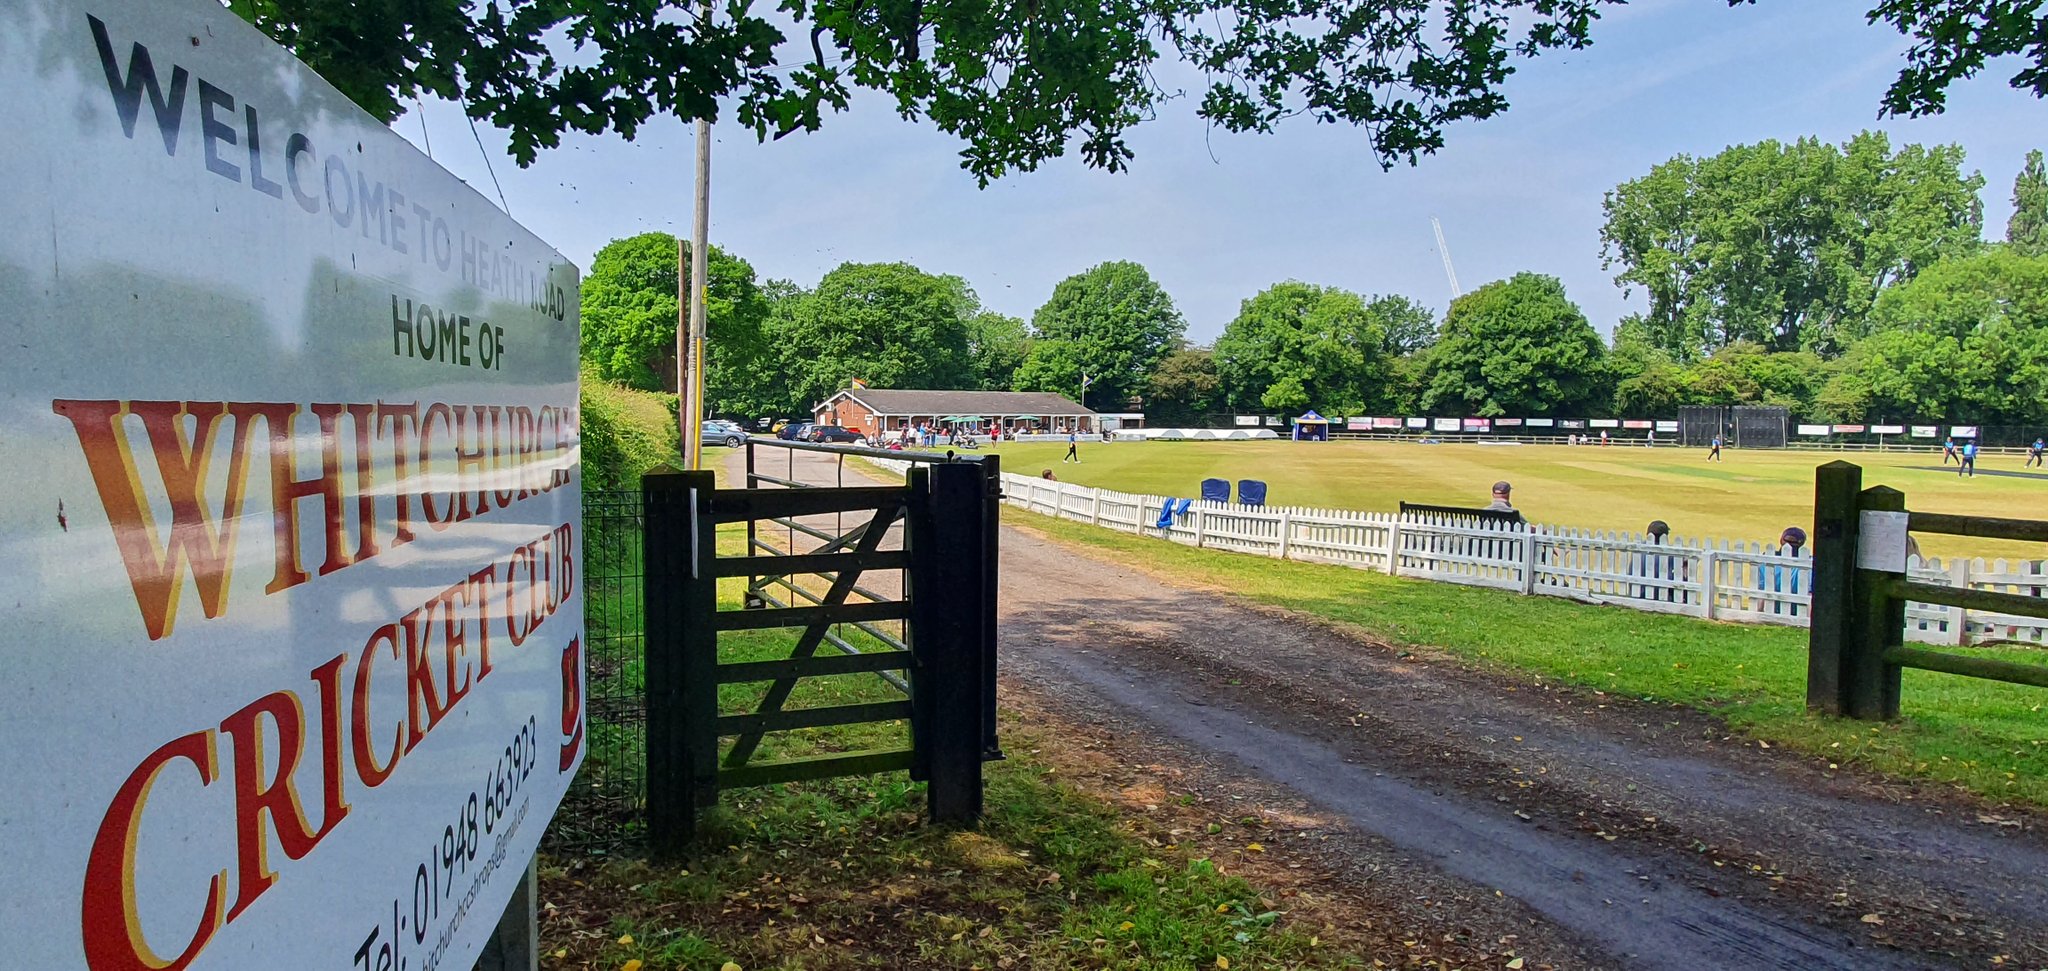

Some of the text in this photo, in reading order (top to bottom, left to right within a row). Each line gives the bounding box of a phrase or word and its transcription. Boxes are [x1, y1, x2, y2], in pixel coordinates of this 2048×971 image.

[86, 12, 565, 322] WELCOME TO HEATH ROAD
[391, 294, 505, 372] HOME OF
[53, 399, 572, 640] WHITCHURCH
[81, 522, 573, 971] CRICKET CLUB
[413, 791, 478, 945] 01948
[484, 714, 537, 835] 663923
